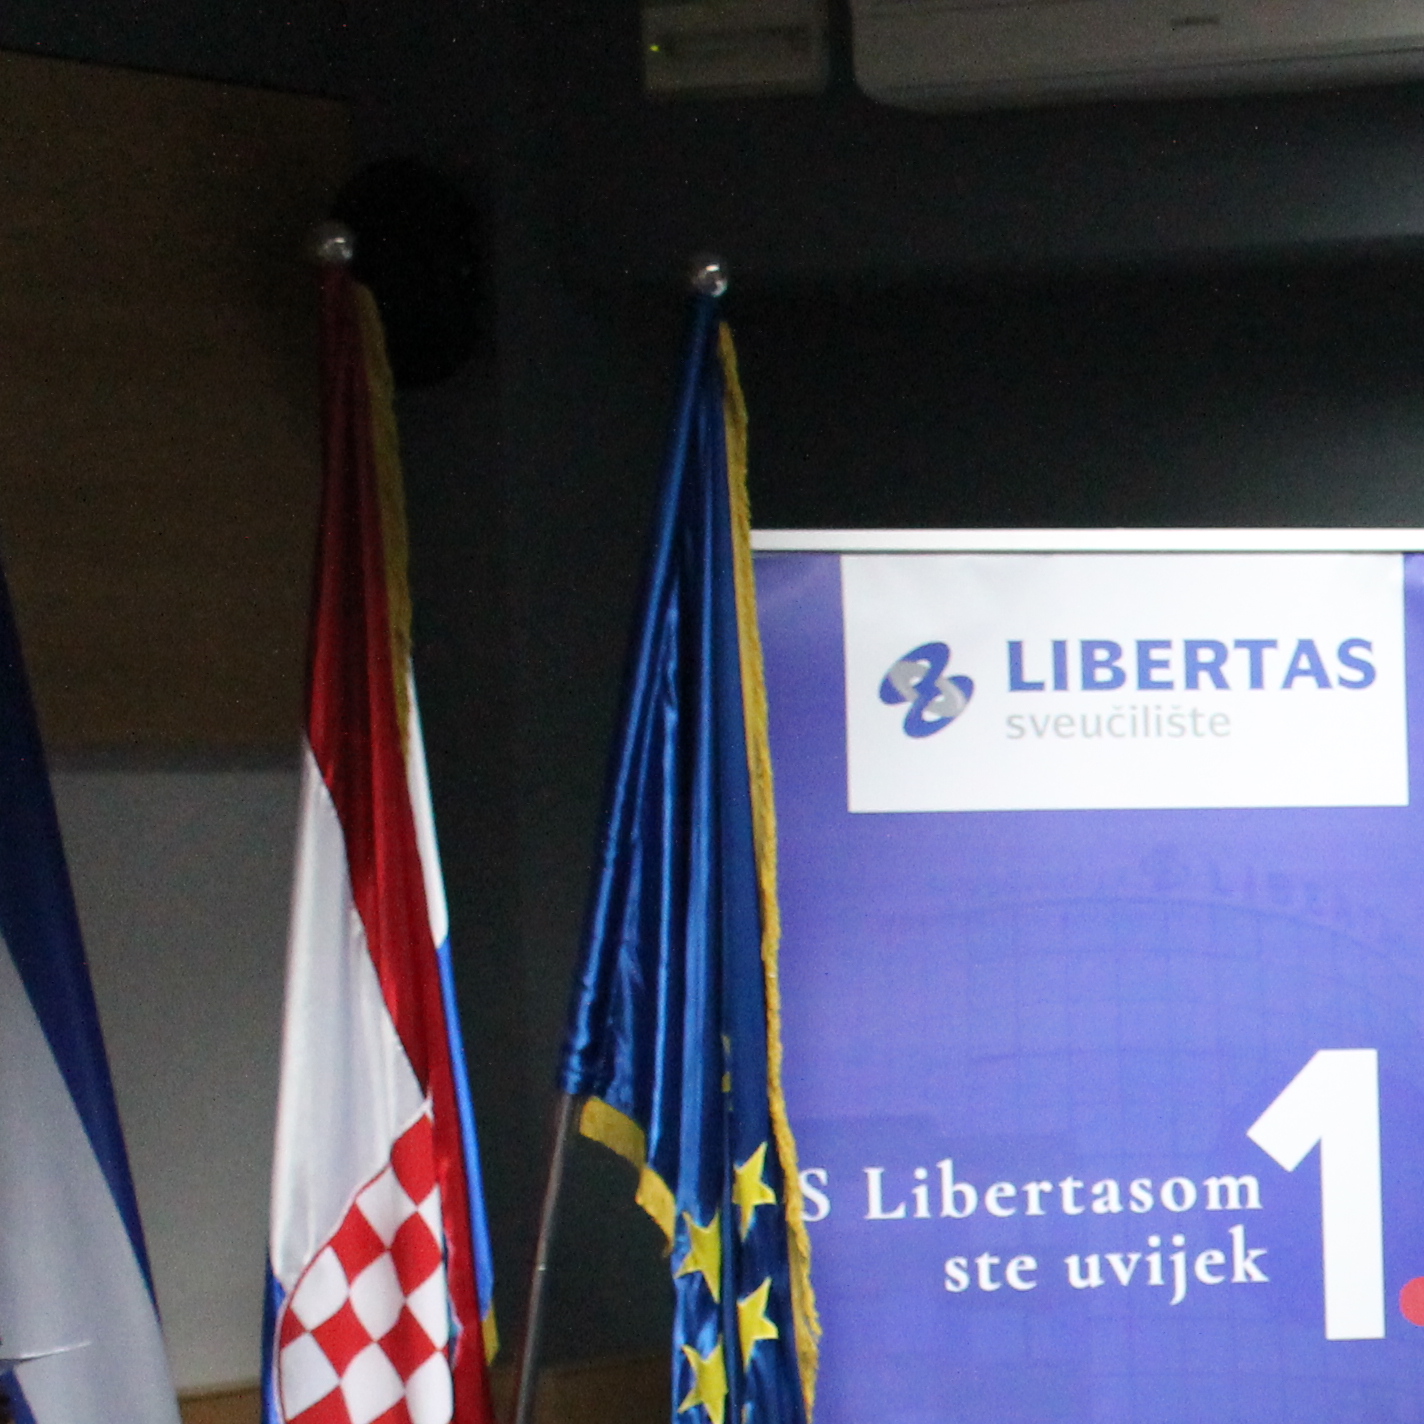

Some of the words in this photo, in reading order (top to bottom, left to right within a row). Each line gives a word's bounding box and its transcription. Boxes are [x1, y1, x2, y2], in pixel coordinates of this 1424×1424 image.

[1006, 637, 1377, 692] LIBERTAS
[1006, 704, 1232, 740] sveučilište
[799, 1168, 830, 1222] S
[863, 1158, 1264, 1221] Libertasom
[944, 1245, 1037, 1293] ste
[1065, 1224, 1270, 1305] uvijek
